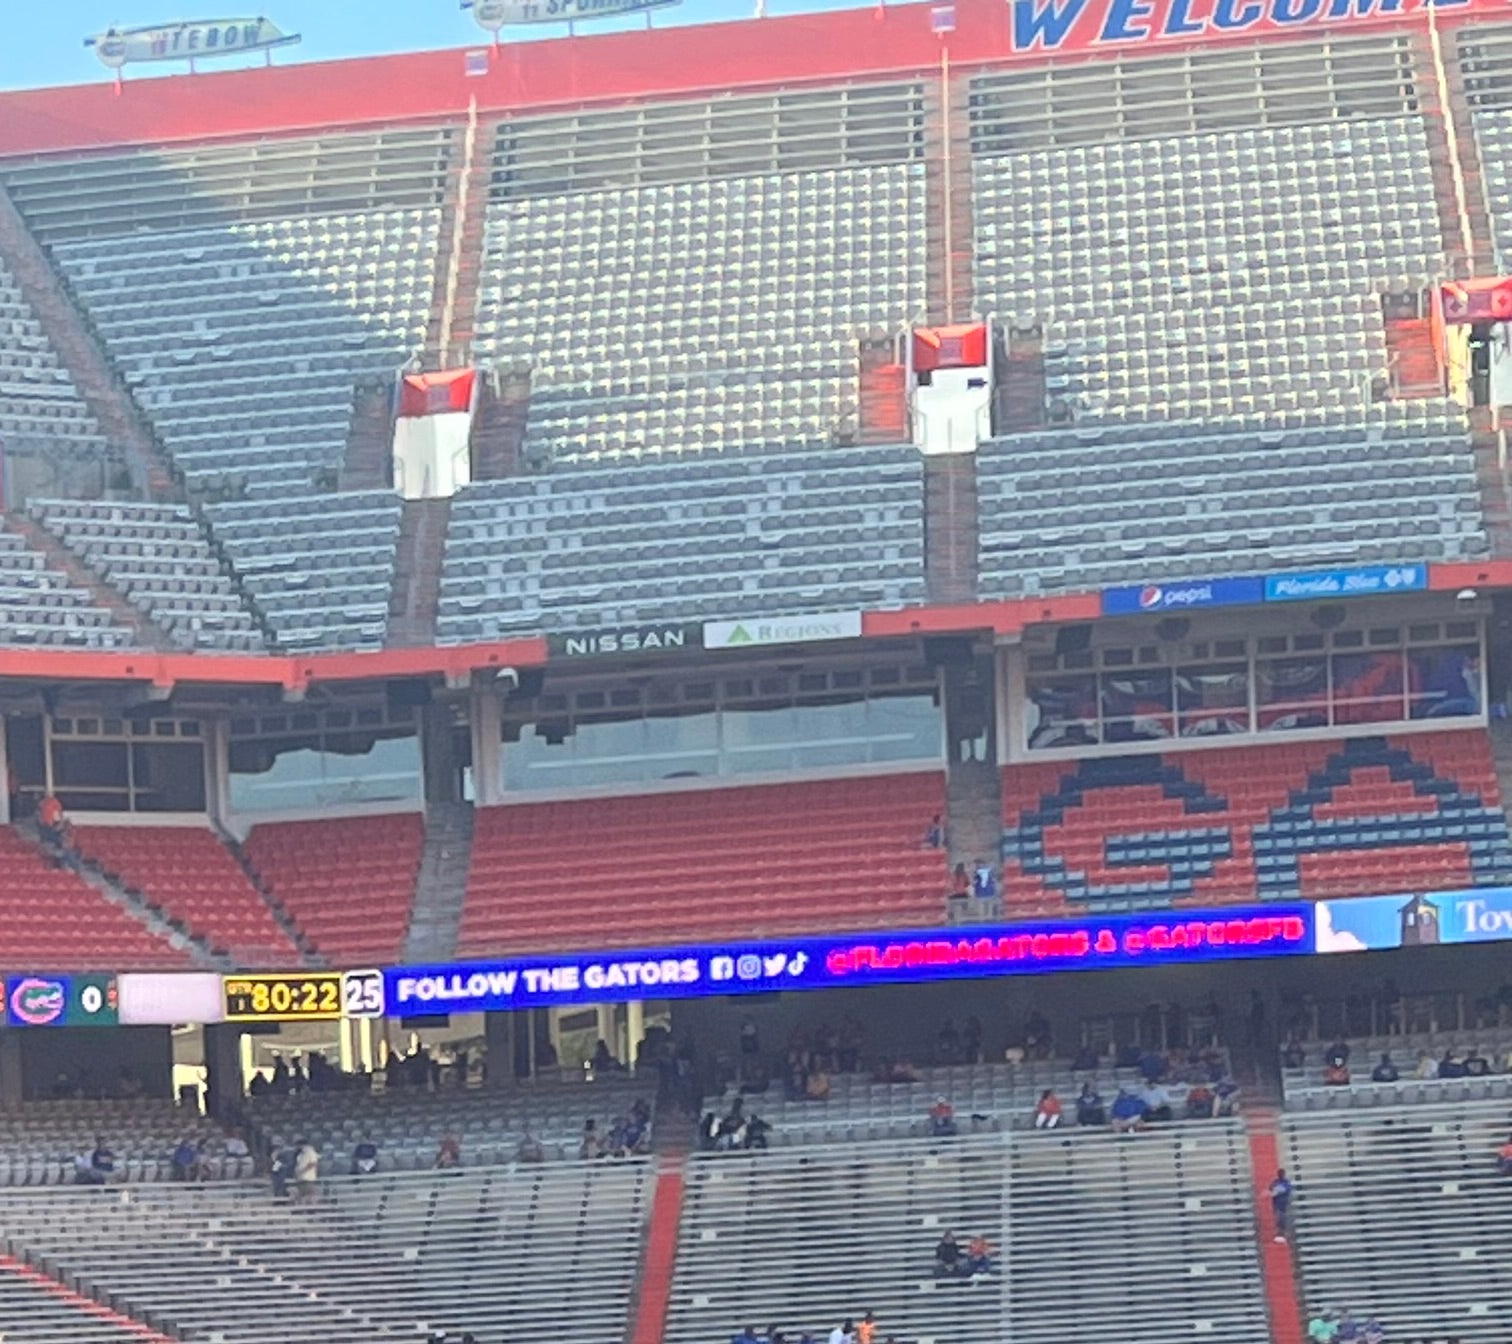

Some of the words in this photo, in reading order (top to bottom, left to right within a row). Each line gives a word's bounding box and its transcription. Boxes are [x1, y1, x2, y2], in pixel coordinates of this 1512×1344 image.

[1008, 0, 1470, 52] WELCO
[1164, 585, 1212, 605] pepsi
[566, 630, 684, 655] NISSAN
[346, 978, 380, 1010] 25
[397, 970, 517, 1002] FOLLOW
[522, 966, 581, 993] THE
[584, 959, 701, 988] GATORS
[81, 985, 103, 1013] 0
